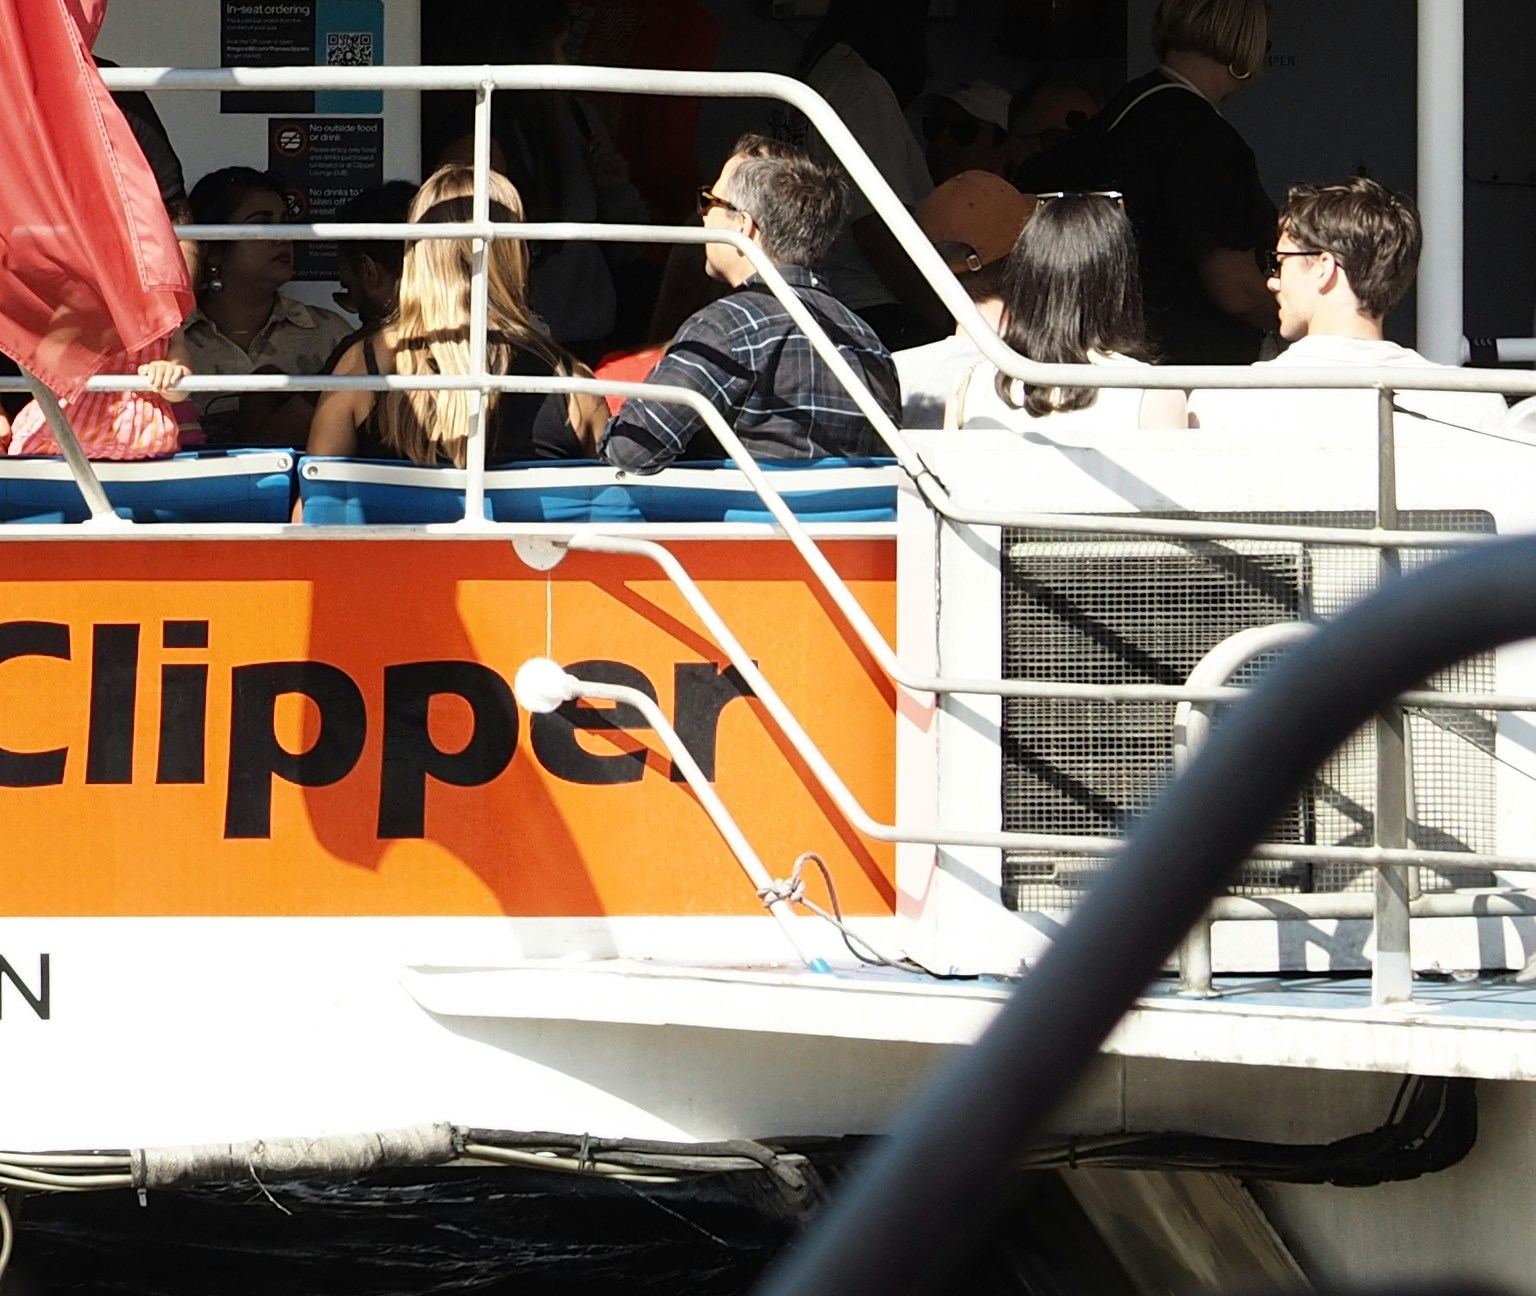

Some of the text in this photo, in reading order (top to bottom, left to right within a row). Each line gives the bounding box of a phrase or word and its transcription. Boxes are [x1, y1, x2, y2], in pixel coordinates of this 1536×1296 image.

[226, 3, 311, 16] In-seat ordering
[309, 124, 377, 132] No outside food
[309, 188, 322, 196] No
[350, 188, 359, 196] to
[333, 197, 346, 205] off
